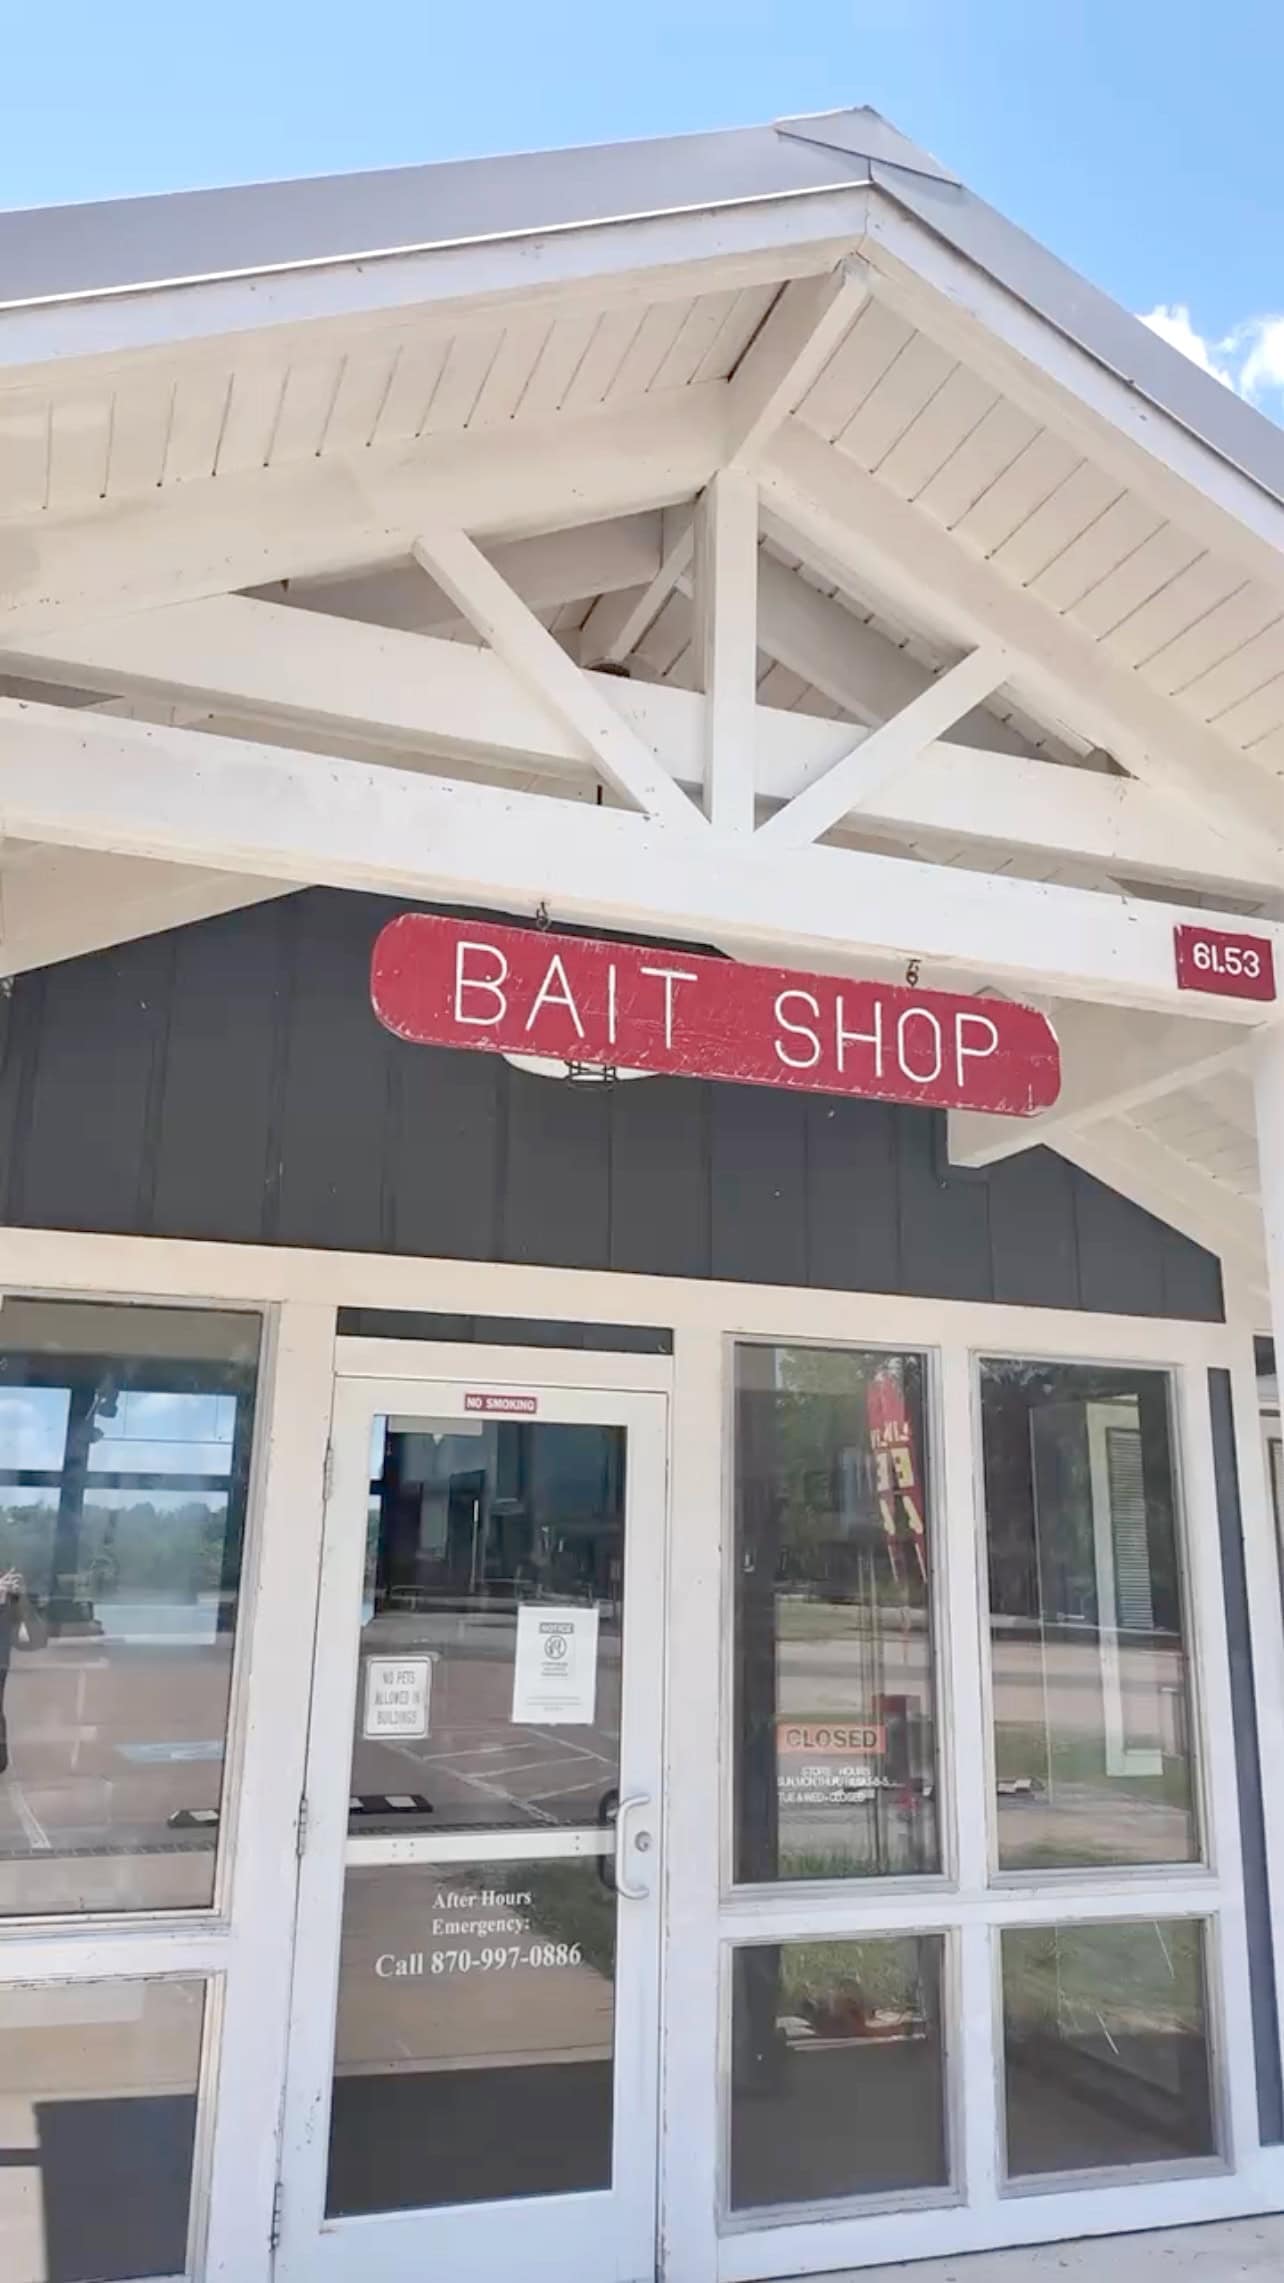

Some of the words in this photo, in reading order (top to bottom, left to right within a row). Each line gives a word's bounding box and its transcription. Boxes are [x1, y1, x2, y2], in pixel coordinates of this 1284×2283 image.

[1192, 942, 1261, 978] 61.53
[453, 941, 698, 1050] BAIT
[774, 990, 999, 1087] SHOP
[466, 1396, 482, 1409] NO
[485, 1397, 535, 1412] SMOKING
[541, 1623, 572, 1633] NOTICE
[382, 1671, 394, 1685] NO
[396, 1670, 416, 1685] PETS
[374, 1691, 409, 1705] ALLOWED
[376, 1710, 417, 1725] BUILDINGS
[786, 1728, 878, 1749] CLOSED
[432, 1891, 477, 1910] After
[481, 1889, 533, 1907] Hours
[432, 1917, 531, 1938] Emergency:
[375, 1953, 424, 1977] Call
[431, 1942, 582, 1974] 870-997-0886
